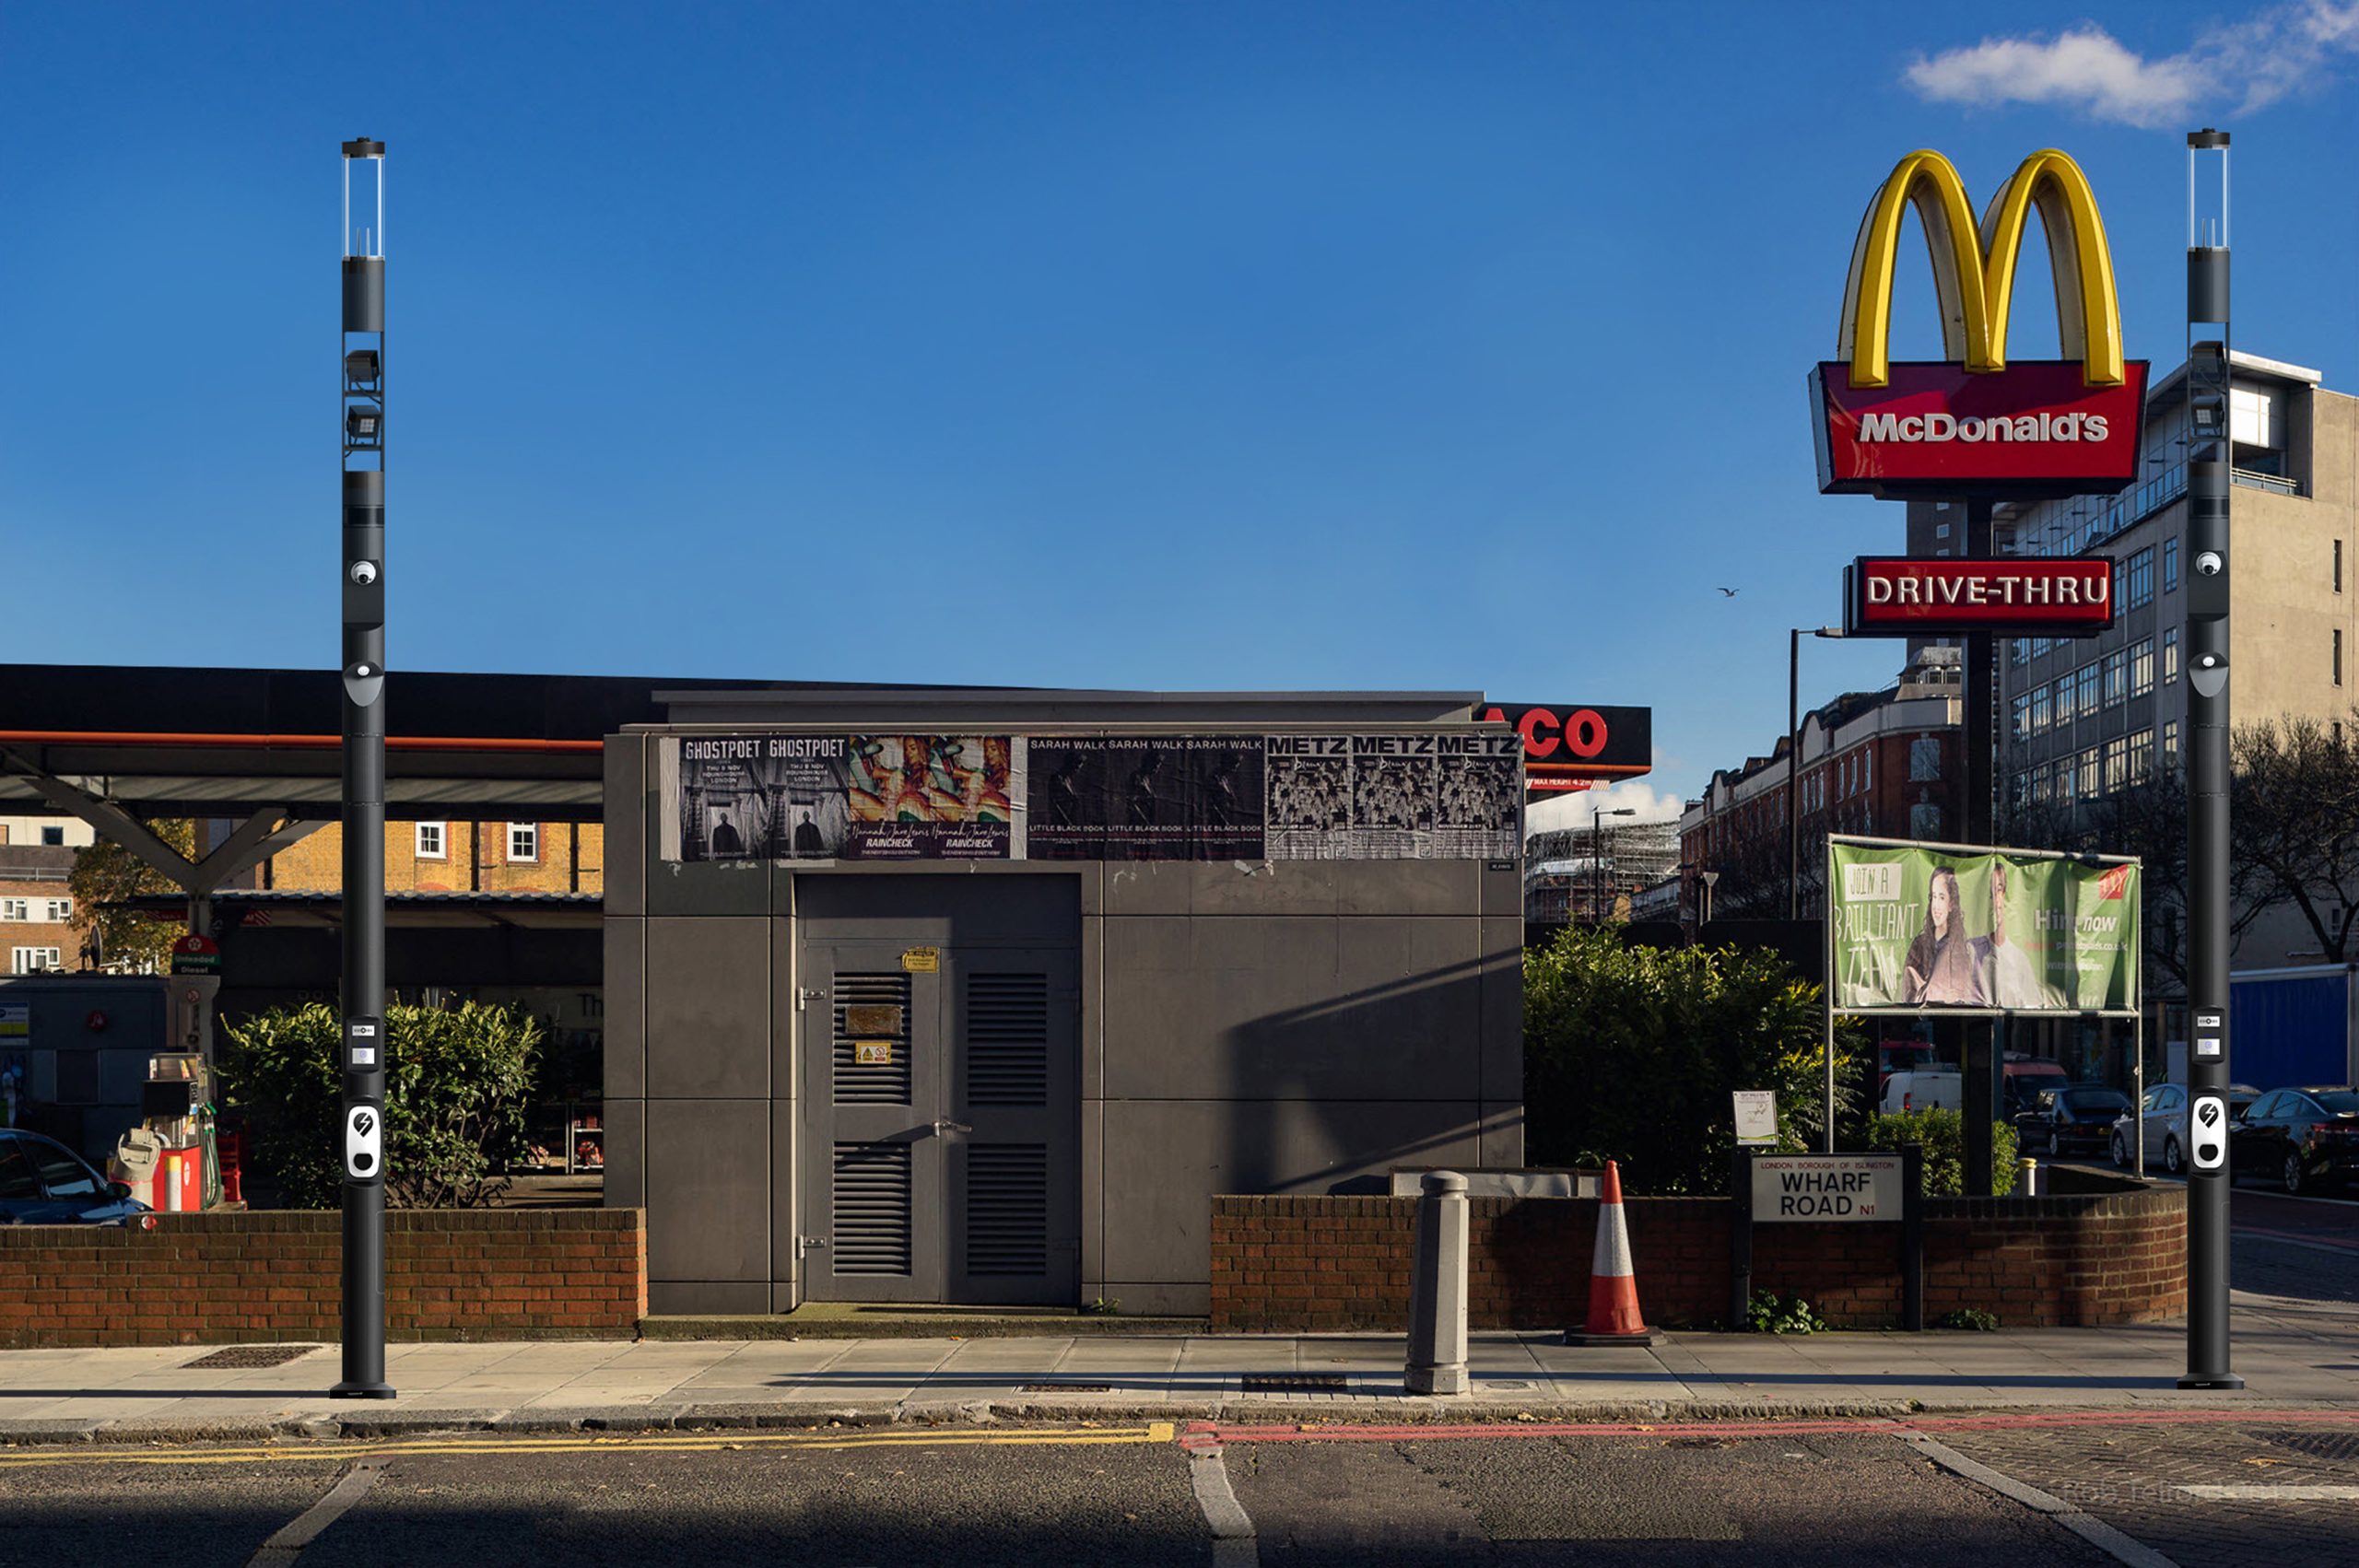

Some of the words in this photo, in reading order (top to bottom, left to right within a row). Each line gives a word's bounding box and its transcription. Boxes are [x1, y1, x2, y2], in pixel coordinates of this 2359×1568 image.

[1860, 413, 2108, 442] McDonald's
[1868, 577, 2107, 604] DRIVE-THRU
[1485, 708, 1608, 757] CO
[686, 741, 761, 759] GHOSTPOET
[769, 739, 845, 757] GHOSTPOET
[1030, 740, 1070, 750] SARAH
[1074, 740, 1106, 750] WALK
[1109, 740, 1147, 750] SARAH
[1152, 740, 1184, 750] WALK
[1187, 740, 1226, 750] SARAH
[1230, 740, 1262, 750] WALK
[1267, 737, 1348, 755] METZ
[1353, 737, 1434, 755] METZ
[1438, 737, 1519, 755] METZ
[1533, 778, 1549, 786] MAX
[852, 821, 886, 839] Hannah
[865, 838, 914, 848] RAINCHECK
[945, 838, 994, 848] RAINCHECK
[1850, 868, 1875, 895] JOIN
[1881, 867, 1889, 895] A
[1835, 903, 1919, 942] BRILLIANT
[2083, 915, 2118, 933] now
[175, 954, 215, 964] Unleaded
[181, 965, 209, 974] Diesel
[1760, 1162, 1793, 1170] LONDON
[1798, 1162, 1835, 1170] BOROUGH
[1839, 1162, 1849, 1170] OF
[1855, 1162, 1895, 1170] ISLINGTON
[1781, 1173, 1871, 1192] WHARF
[1780, 1196, 1852, 1216] ROAD
[1860, 1205, 1875, 1215] N1
